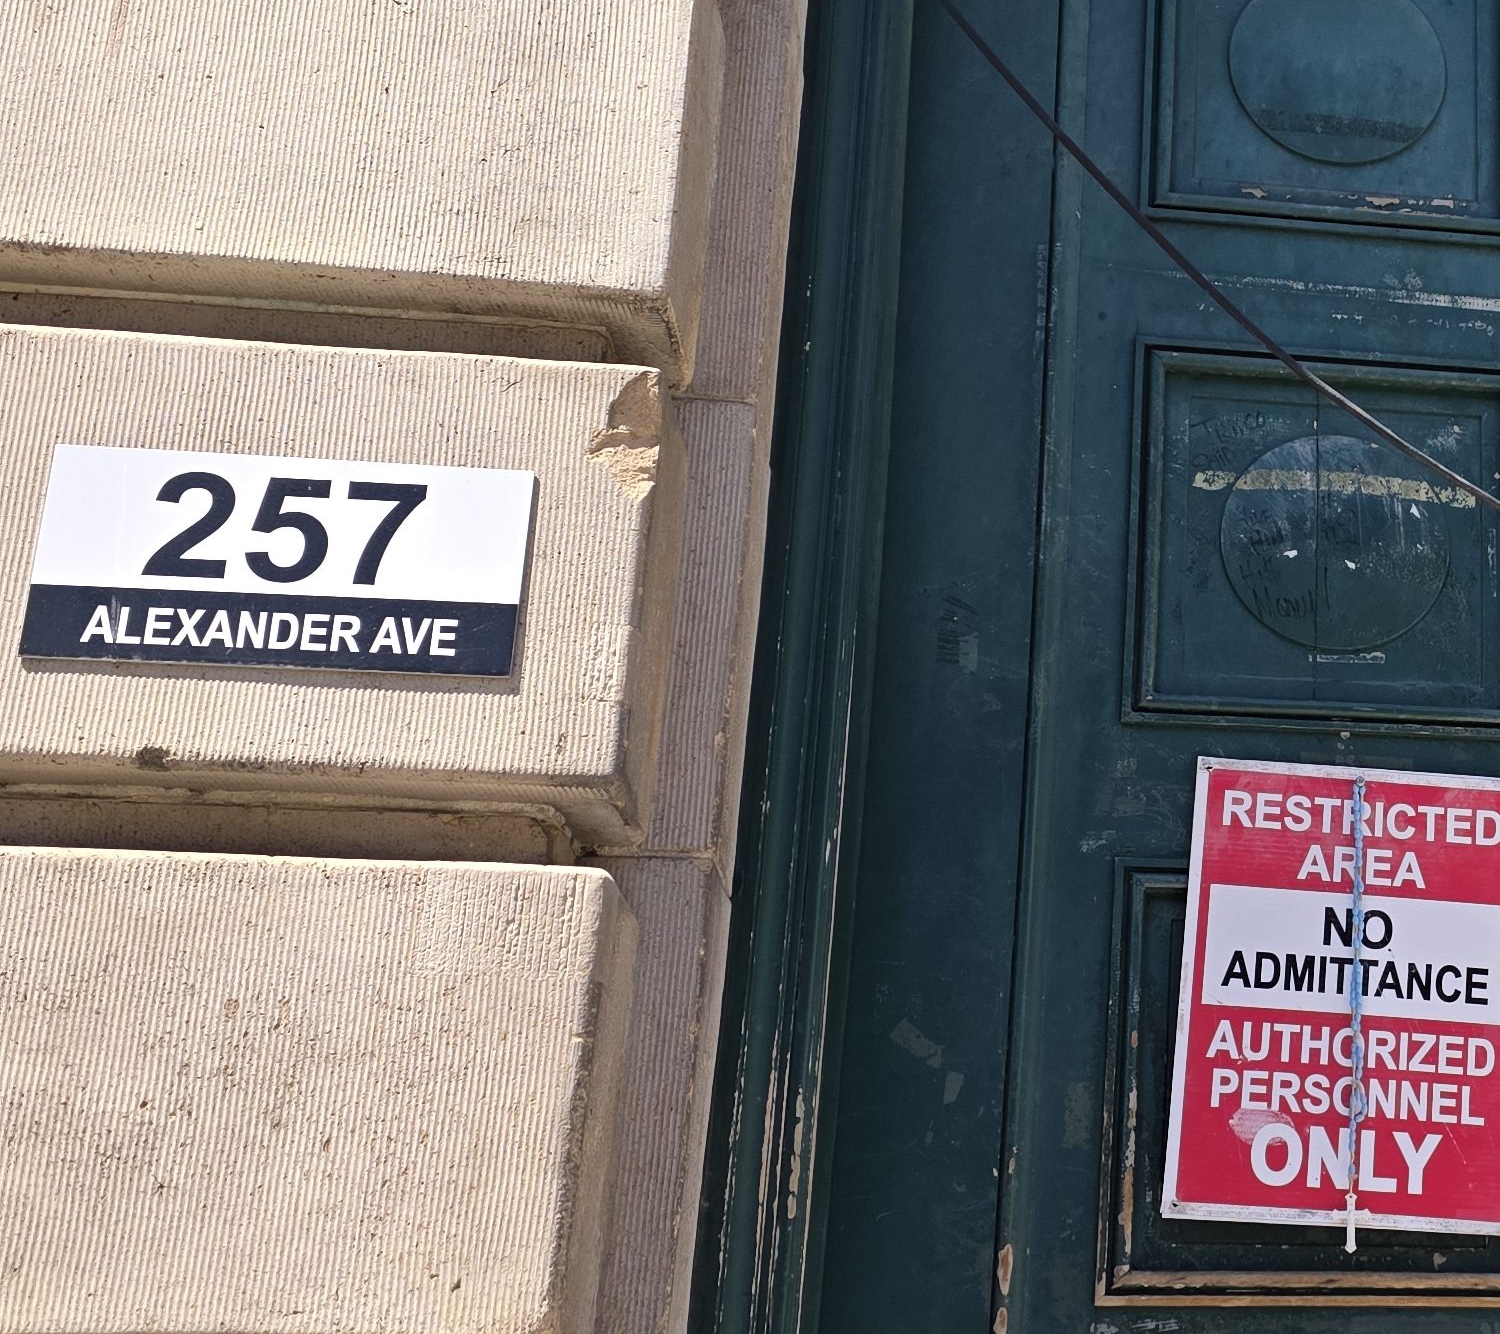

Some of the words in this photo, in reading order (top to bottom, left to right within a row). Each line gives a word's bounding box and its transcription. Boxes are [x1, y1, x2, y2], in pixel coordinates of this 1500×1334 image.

[141, 471, 428, 586] 257
[80, 604, 360, 653] ALEXANDER
[370, 616, 459, 657] AVE
[1297, 844, 1426, 889] AREA
[1322, 906, 1393, 949] NO
[1220, 950, 1489, 1006] ADMITTANCE
[1205, 1020, 1496, 1077] AUTHORIZED
[1210, 1069, 1485, 1126] PERSONNEL
[1250, 1123, 1444, 1195] ONLY
